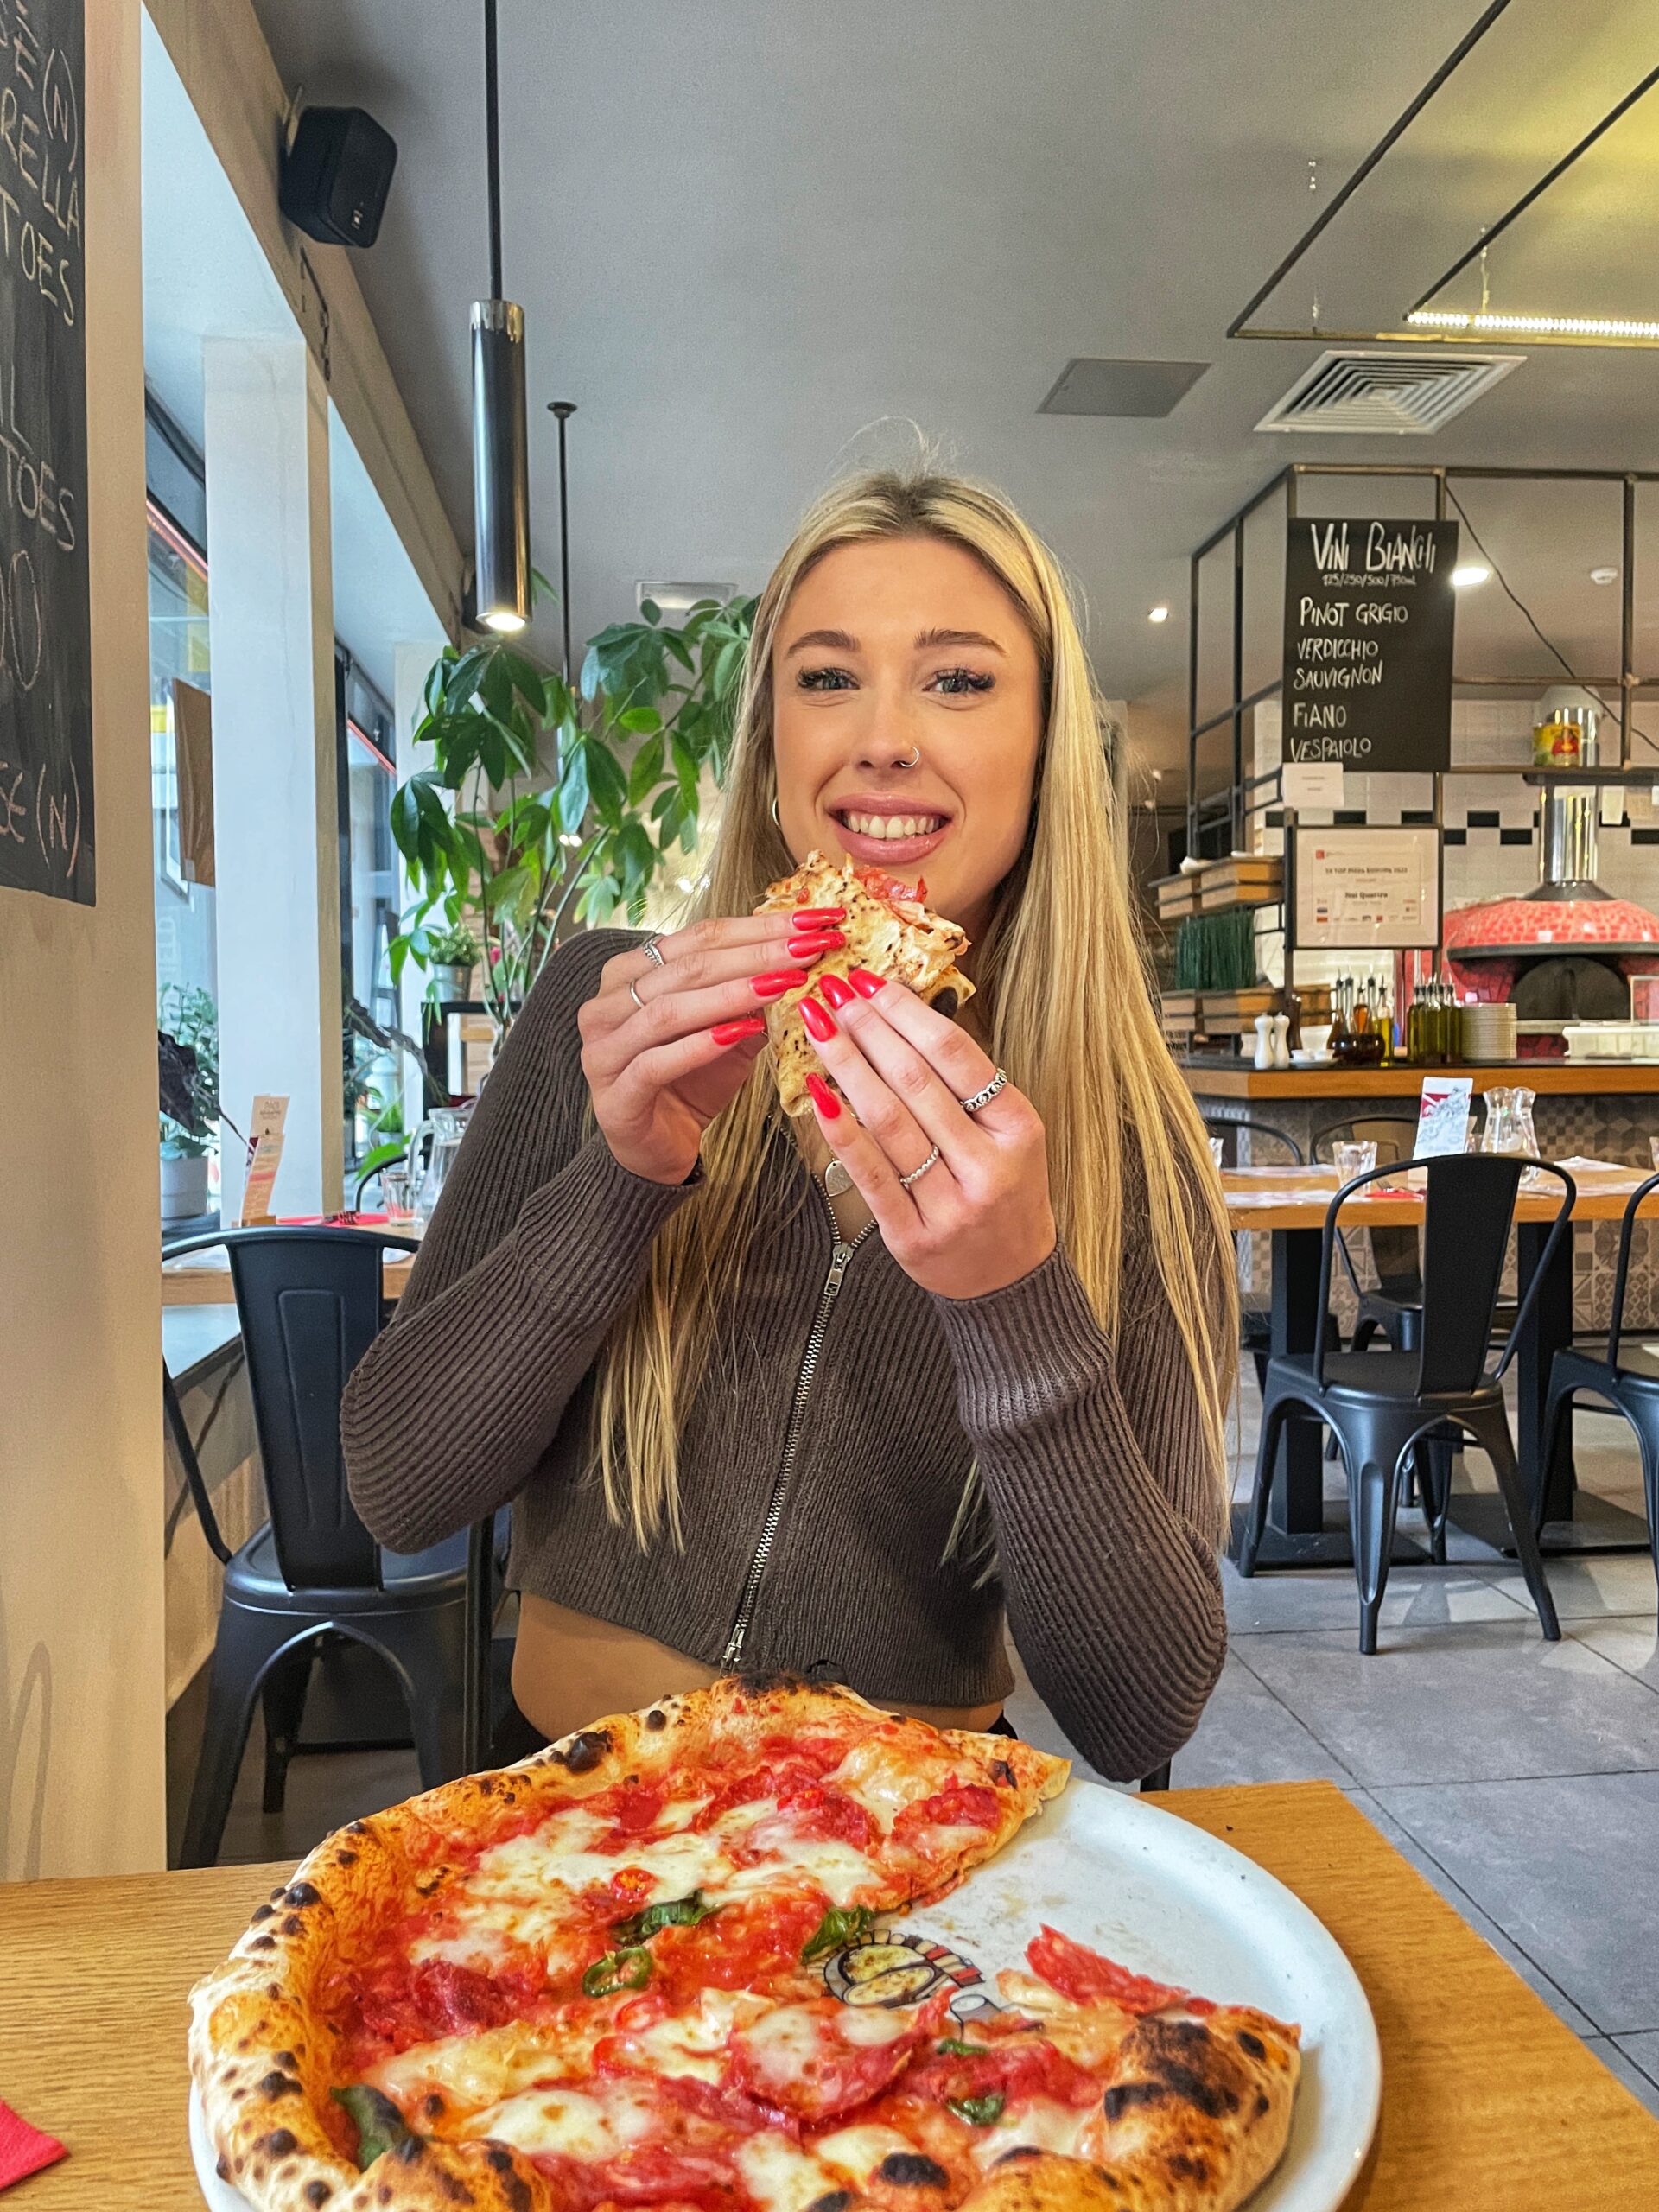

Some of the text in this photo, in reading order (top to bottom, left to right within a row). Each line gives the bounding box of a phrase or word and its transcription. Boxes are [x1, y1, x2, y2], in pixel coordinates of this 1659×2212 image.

[1311, 521, 1436, 573] VINI BIANCHI
[1300, 596, 1408, 626] PINOT GRIGIO
[1297, 638, 1378, 661] VERDICCHIO
[1294, 660, 1382, 690] SAUVIGNON
[1294, 703, 1347, 728] FIANO
[1290, 738, 1372, 761] VESPAIOLO
